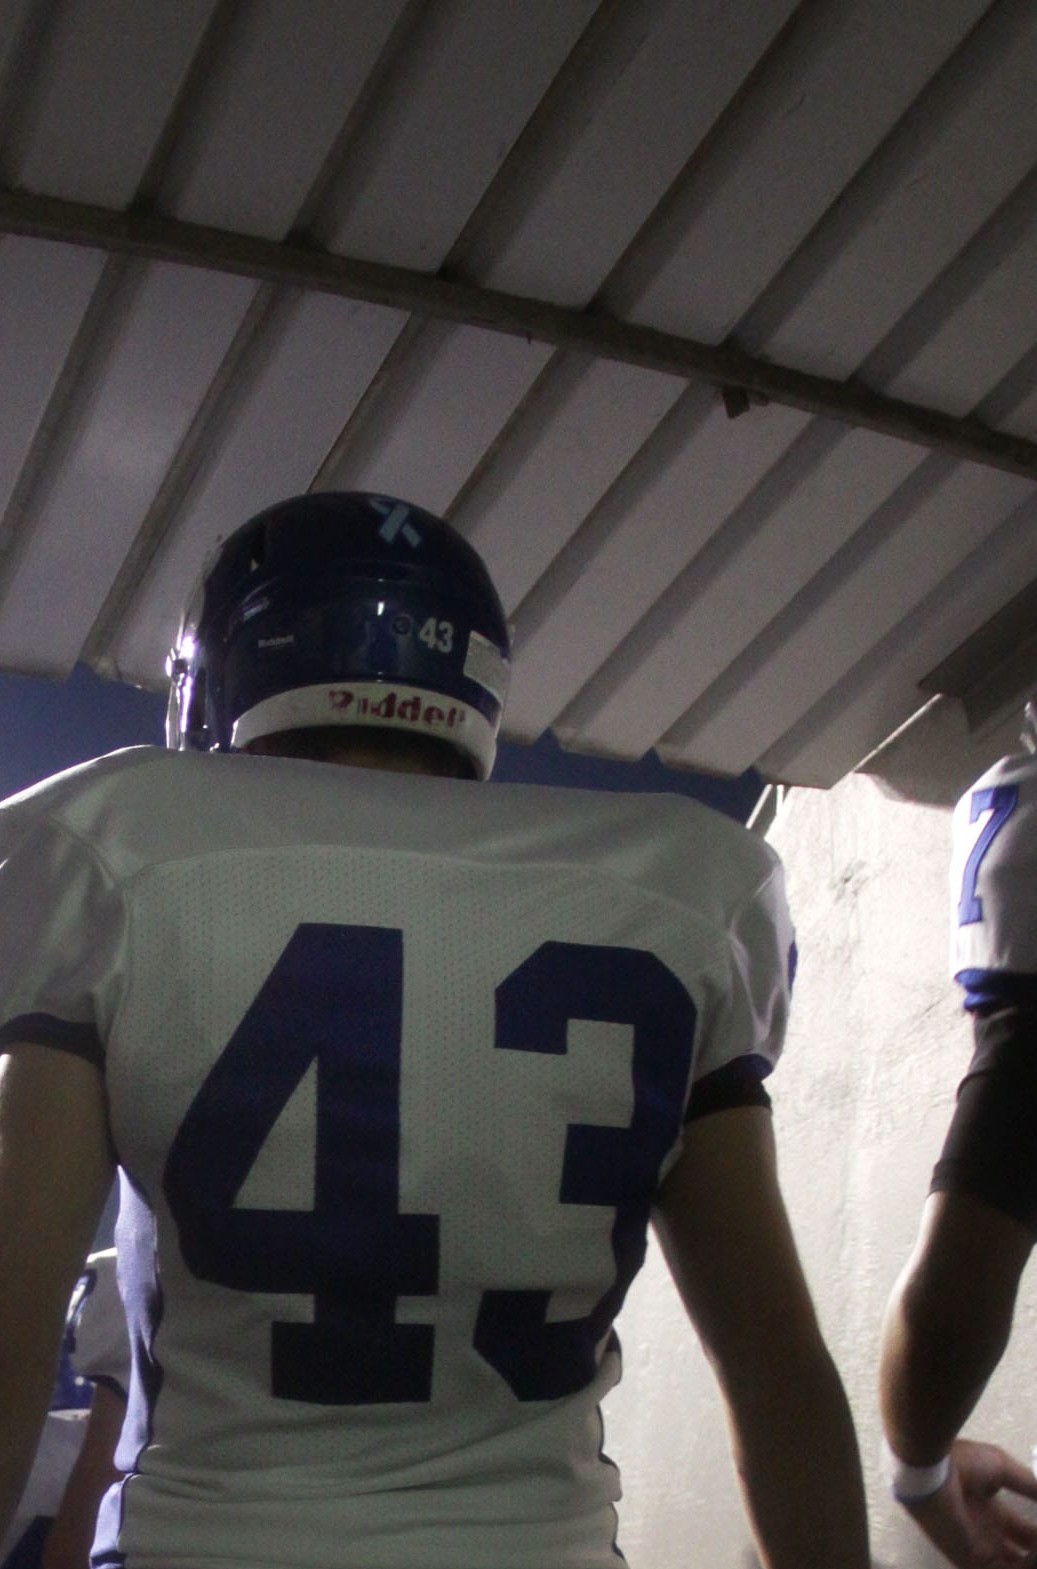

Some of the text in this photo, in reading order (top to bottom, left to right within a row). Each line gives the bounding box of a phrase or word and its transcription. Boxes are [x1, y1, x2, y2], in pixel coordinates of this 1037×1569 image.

[419, 618, 454, 653] 43
[958, 784, 1020, 928] 7
[164, 922, 698, 1405] 43
